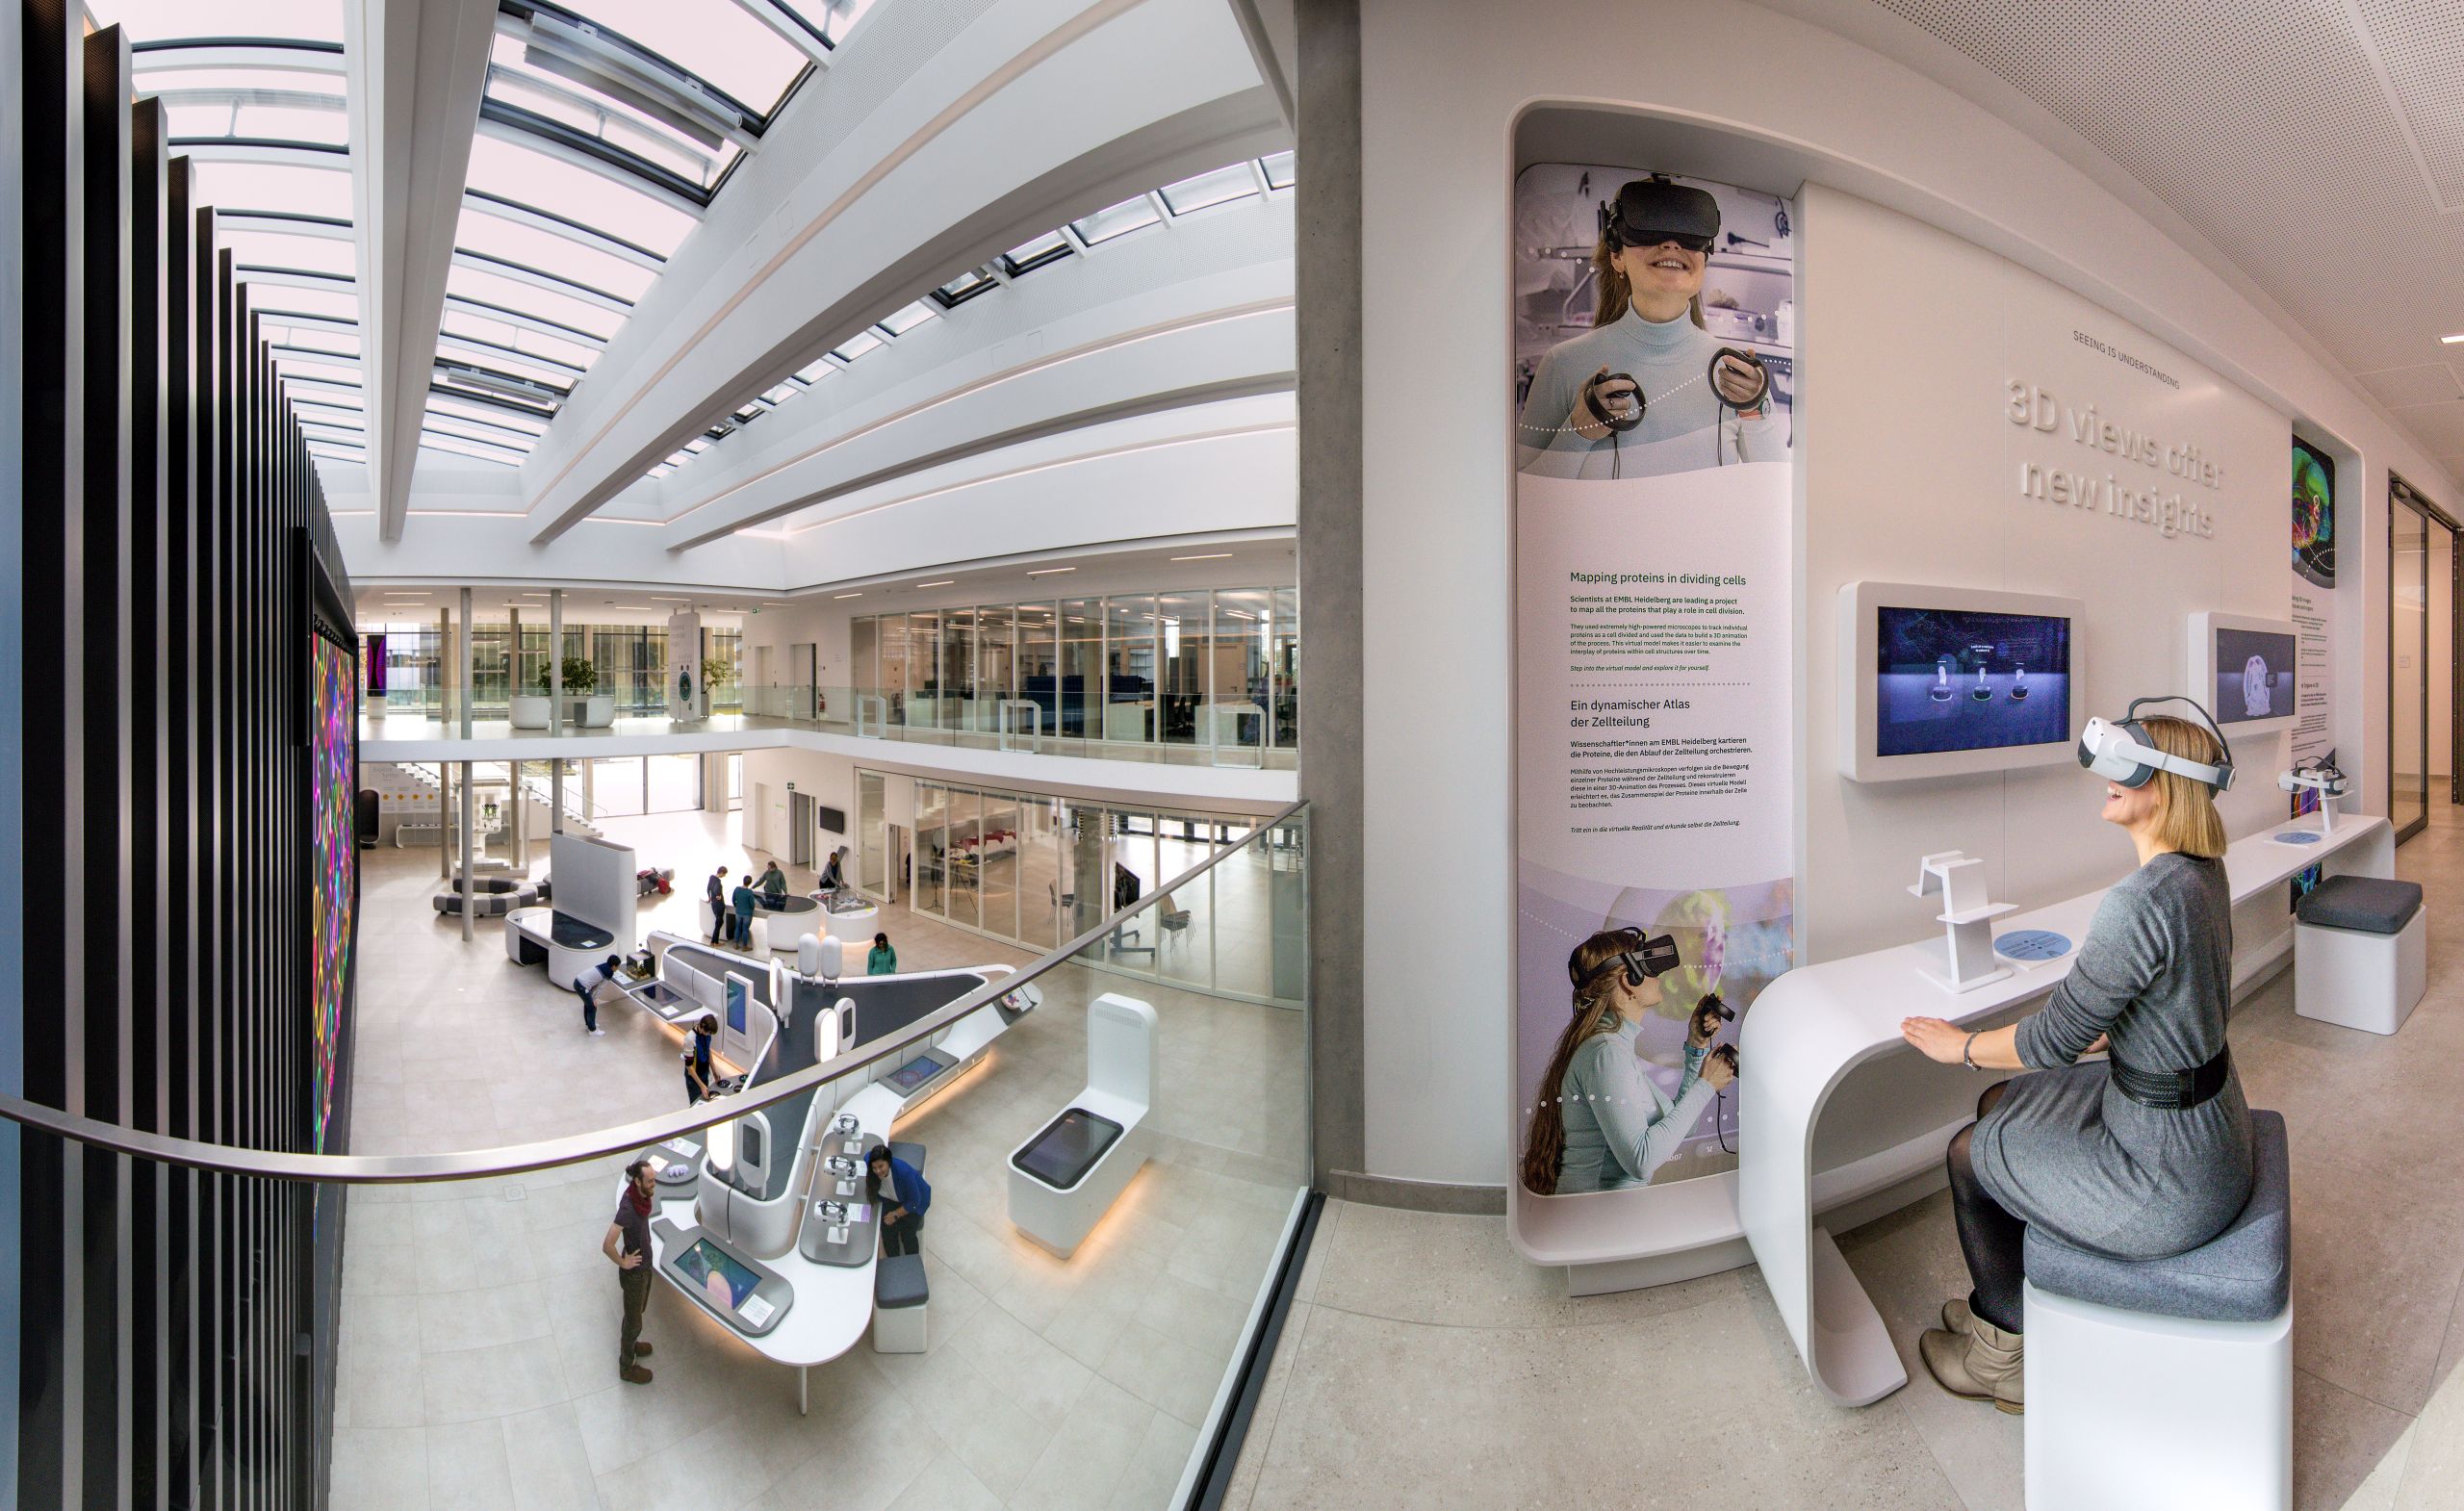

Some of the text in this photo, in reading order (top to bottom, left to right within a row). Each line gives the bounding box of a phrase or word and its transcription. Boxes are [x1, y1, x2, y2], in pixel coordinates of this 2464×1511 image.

[2073, 330, 2180, 390] SEEING IS UNDERSTANDING
[2008, 378, 2223, 489] 3D views offer
[2019, 462, 2213, 539] new insights
[1571, 572, 1746, 587] Mapping proteins in dividing cells
[1634, 597, 1671, 605] Heidelberg
[1684, 597, 1708, 605] leading
[1715, 597, 1737, 605] project
[1618, 606, 1647, 615] proteins
[1571, 699, 1690, 712] Ein dynamischer Atlas
[1571, 716, 1650, 730] der Zellteilung
[1681, 737, 1717, 747] Heidelberg
[1675, 748, 1708, 756] Zellteilung
